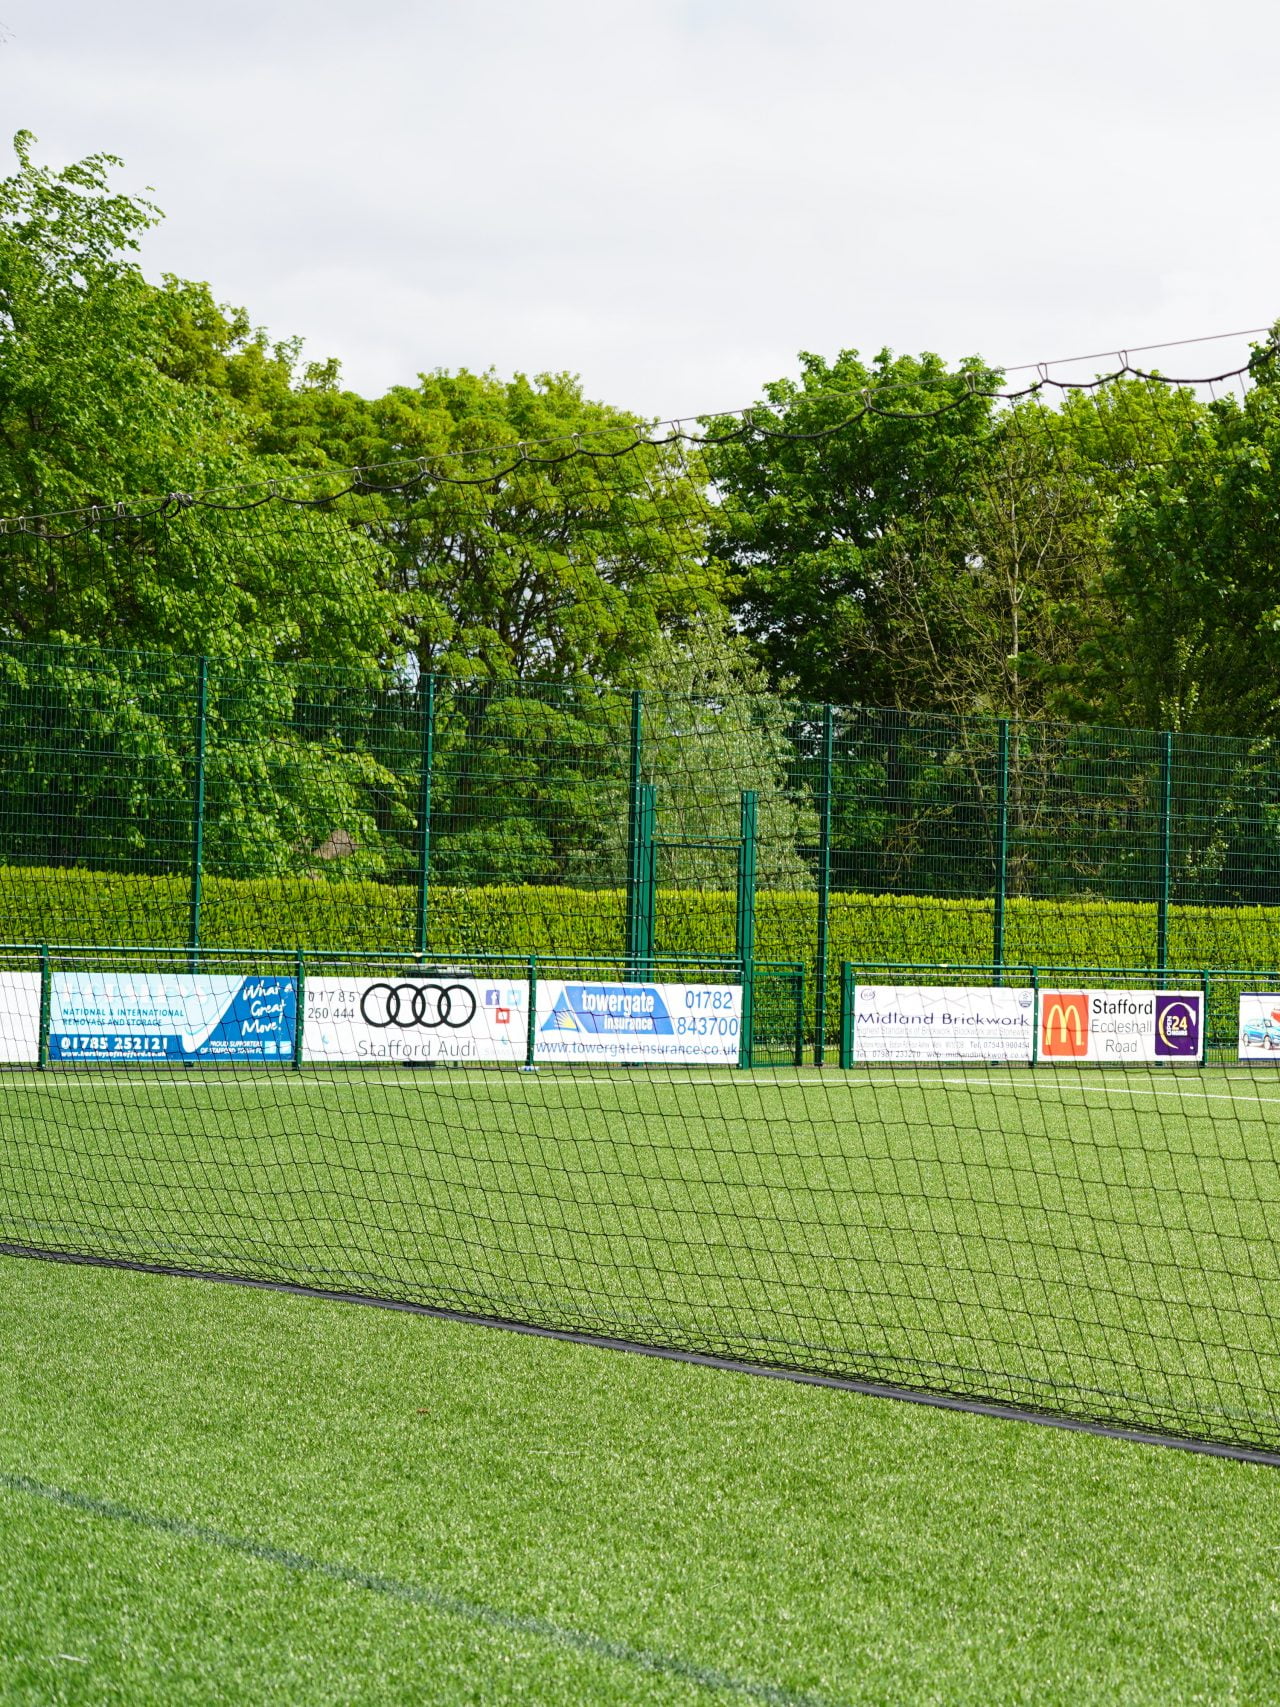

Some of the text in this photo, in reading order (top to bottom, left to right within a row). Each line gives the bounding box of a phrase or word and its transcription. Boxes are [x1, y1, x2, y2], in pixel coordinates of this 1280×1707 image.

[243, 980, 280, 1000] What
[581, 989, 655, 1017] towergate
[685, 990, 733, 1010] 01782
[1092, 998, 1154, 1016] Stafford
[62, 1008, 107, 1016] NATIONAL
[117, 1009, 185, 1017] INTERNATIONAL
[250, 999, 286, 1018] Great
[308, 1007, 355, 1020] 250 444
[62, 1018, 106, 1026] REMOVALS
[126, 1019, 163, 1027] STORAGE
[241, 1014, 284, 1036] Move!
[677, 1017, 738, 1036] 843700
[857, 1011, 1030, 1026] Midland Brickwork
[1091, 1018, 1153, 1034] Eccleshall
[1172, 1015, 1188, 1031] 24
[61, 1037, 169, 1050] 01785 252121
[357, 1040, 431, 1057] Stafford
[437, 1040, 476, 1057] Audi
[536, 1041, 738, 1057] www.towergateinsurance.co.uk
[1105, 1039, 1138, 1054] Road
